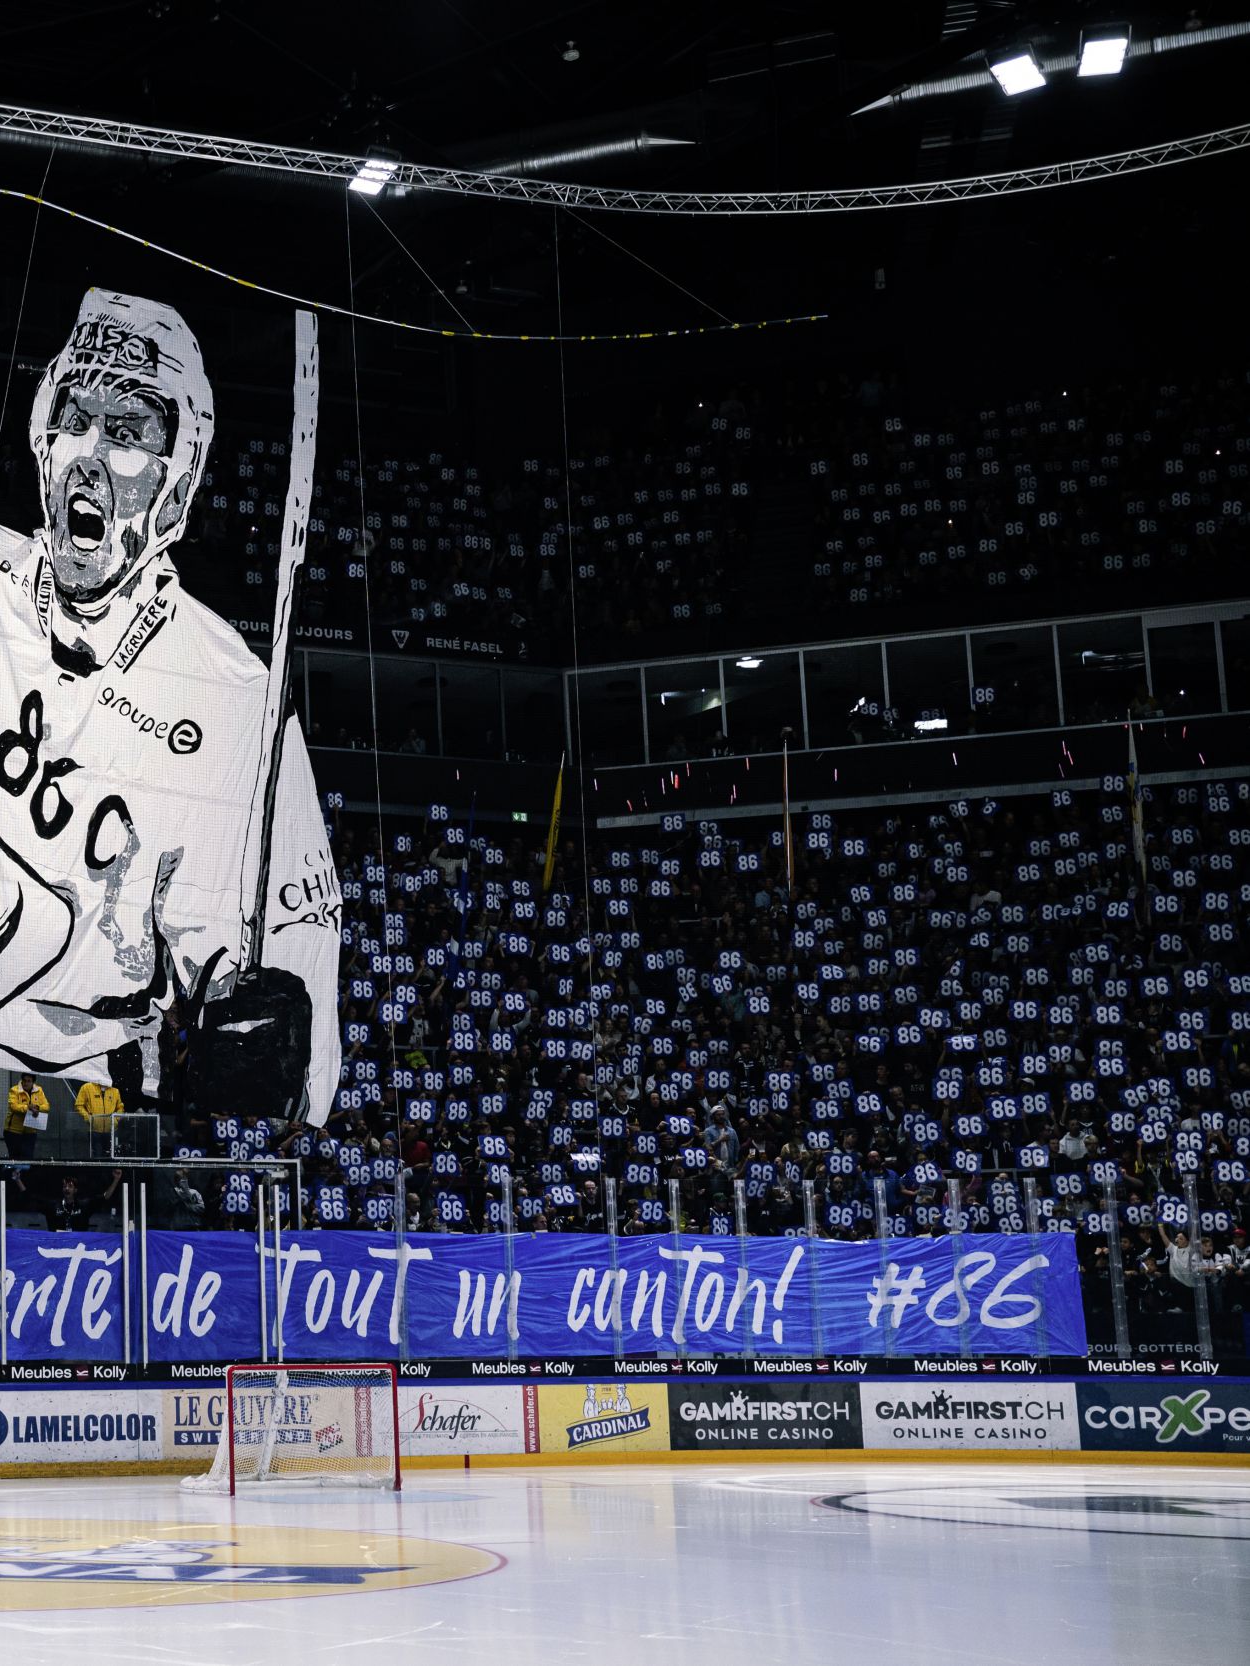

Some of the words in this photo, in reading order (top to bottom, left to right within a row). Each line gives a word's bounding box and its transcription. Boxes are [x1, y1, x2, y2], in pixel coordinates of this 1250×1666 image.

[1165, 459, 1184, 474] 86
[731, 482, 749, 496] 86
[593, 515, 611, 530] 86
[1103, 554, 1123, 570] 86
[987, 571, 1007, 585] 86
[849, 587, 868, 602] 86
[426, 636, 461, 649] RENÉ
[464, 641, 504, 655] FASEL
[975, 687, 995, 703] 86
[97, 686, 170, 741] groupe
[431, 804, 449, 821] 86
[663, 814, 683, 832] 86
[807, 831, 829, 849] 86
[1172, 869, 1197, 888] 86
[1106, 901, 1129, 918] 86
[1143, 976, 1169, 996] 86
[382, 1003, 404, 1023] 86
[919, 1008, 944, 1028] 86
[1164, 1030, 1191, 1051] 86
[340, 1089, 362, 1109] 86
[913, 1121, 939, 1142] 86
[483, 1136, 506, 1156] 86
[684, 1148, 707, 1167] 86
[1217, 1161, 1245, 1182] 86
[441, 1199, 463, 1221] 86
[641, 1201, 663, 1221] 86
[152, 1244, 223, 1339] de
[453, 1269, 521, 1341] un
[867, 1251, 1051, 1329] #86
[11, 1366, 72, 1379] Meubles
[94, 1365, 127, 1380] Kolly
[171, 1364, 227, 1377] Meubles
[400, 1364, 431, 1377] Kolly
[472, 1363, 526, 1374] Meubles
[545, 1362, 575, 1376] Kolly
[614, 1361, 668, 1373] Meubles
[687, 1361, 718, 1374] Kolly
[754, 1360, 812, 1372] Meubles
[834, 1360, 867, 1374] Kolly
[914, 1360, 978, 1372] Meubles
[1001, 1359, 1037, 1374] Kolly
[1088, 1360, 1156, 1372] Meubles
[1181, 1360, 1219, 1375] Kolly
[174, 1395, 201, 1427] LE
[412, 1392, 481, 1440] Schafer
[527, 1385, 537, 1452] www.schafer.ch
[13, 1413, 157, 1443] LAMELCOLOR
[572, 1412, 646, 1442] CARDINAL
[695, 1427, 759, 1440] ONLINE
[768, 1427, 834, 1440] CASINO
[893, 1427, 964, 1439] ONLINE
[975, 1426, 1048, 1439] CASINO
[1223, 1433, 1244, 1442] Pour
